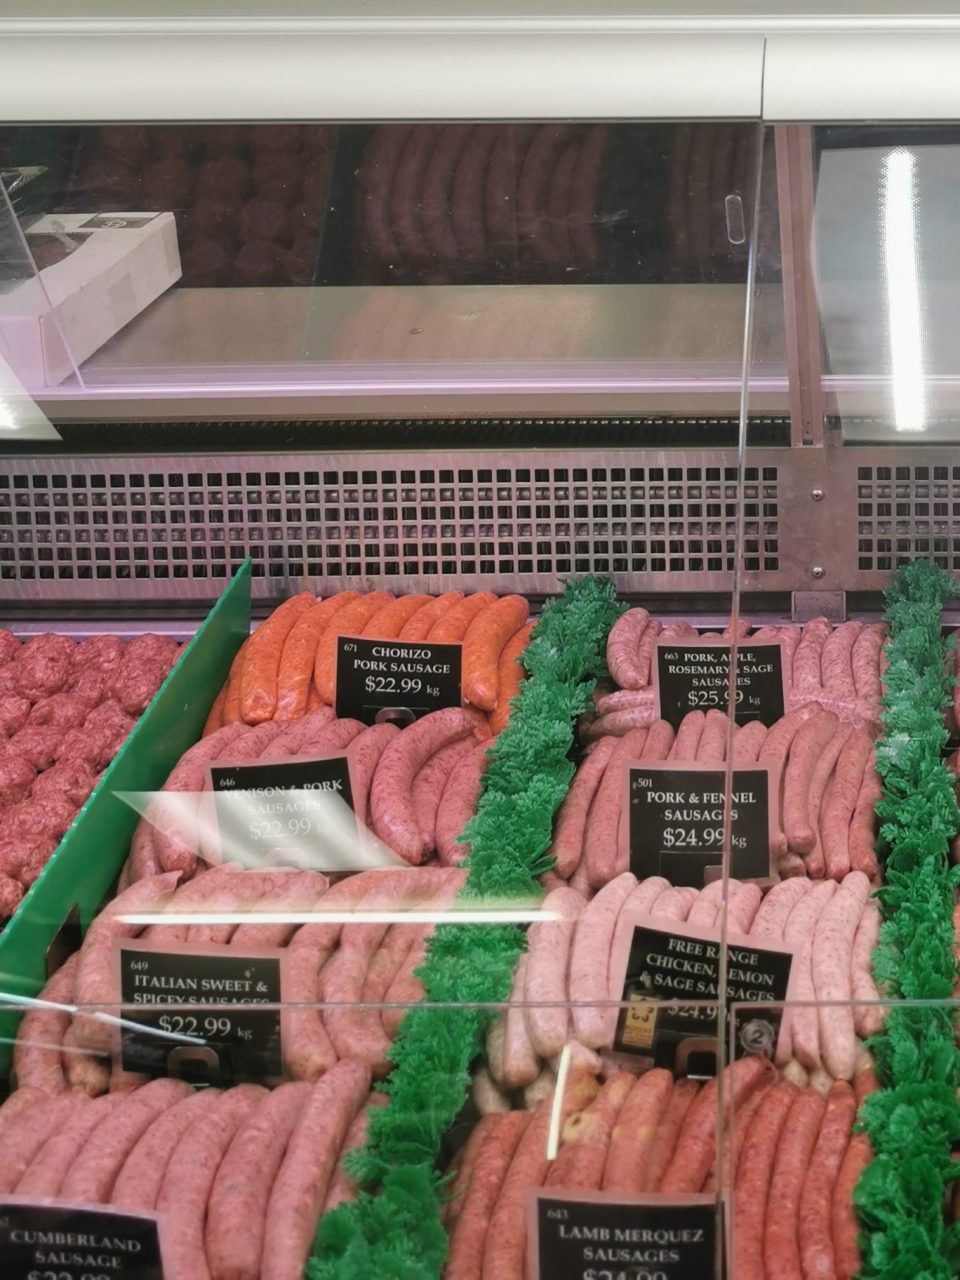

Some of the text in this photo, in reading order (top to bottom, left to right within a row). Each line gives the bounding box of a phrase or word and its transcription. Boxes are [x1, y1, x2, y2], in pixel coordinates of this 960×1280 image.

[344, 643, 357, 652] 671
[372, 646, 431, 659] CHORIZO
[664, 652, 679, 660] 663
[684, 653, 756, 662] PORK, ALE,
[354, 660, 450, 674] PORK SAUSAGE
[668, 665, 730, 674] ROSEMARY
[743, 664, 774, 673] SAGE
[365, 675, 440, 697] $22.99 kg
[692, 677, 751, 687] SAUSAES
[749, 695, 761, 705] kg
[220, 778, 236, 787] 646
[289, 784, 301, 795] &
[303, 779, 343, 795] PORK
[638, 778, 653, 788] 501
[647, 791, 685, 803] PORK
[688, 792, 700, 804] &
[664, 809, 738, 821] SAUSAGS
[663, 827, 747, 848] $24.99 kg
[668, 938, 704, 956] FREE
[130, 960, 149, 970] 649
[646, 953, 775, 986] CHICKEN, EMON
[134, 974, 268, 992] ITALIAN SWEET &
[654, 973, 694, 991] SAGE
[696, 980, 775, 1001] SASAGES
[159, 1014, 252, 1040] $22.99 kg
[10, 1230, 141, 1252] CUMBERLAND
[559, 1224, 704, 1244] LAMB MERQUEZ
[35, 1251, 122, 1269] SAUSAGE
[583, 1247, 680, 1262] SAUSAGES
